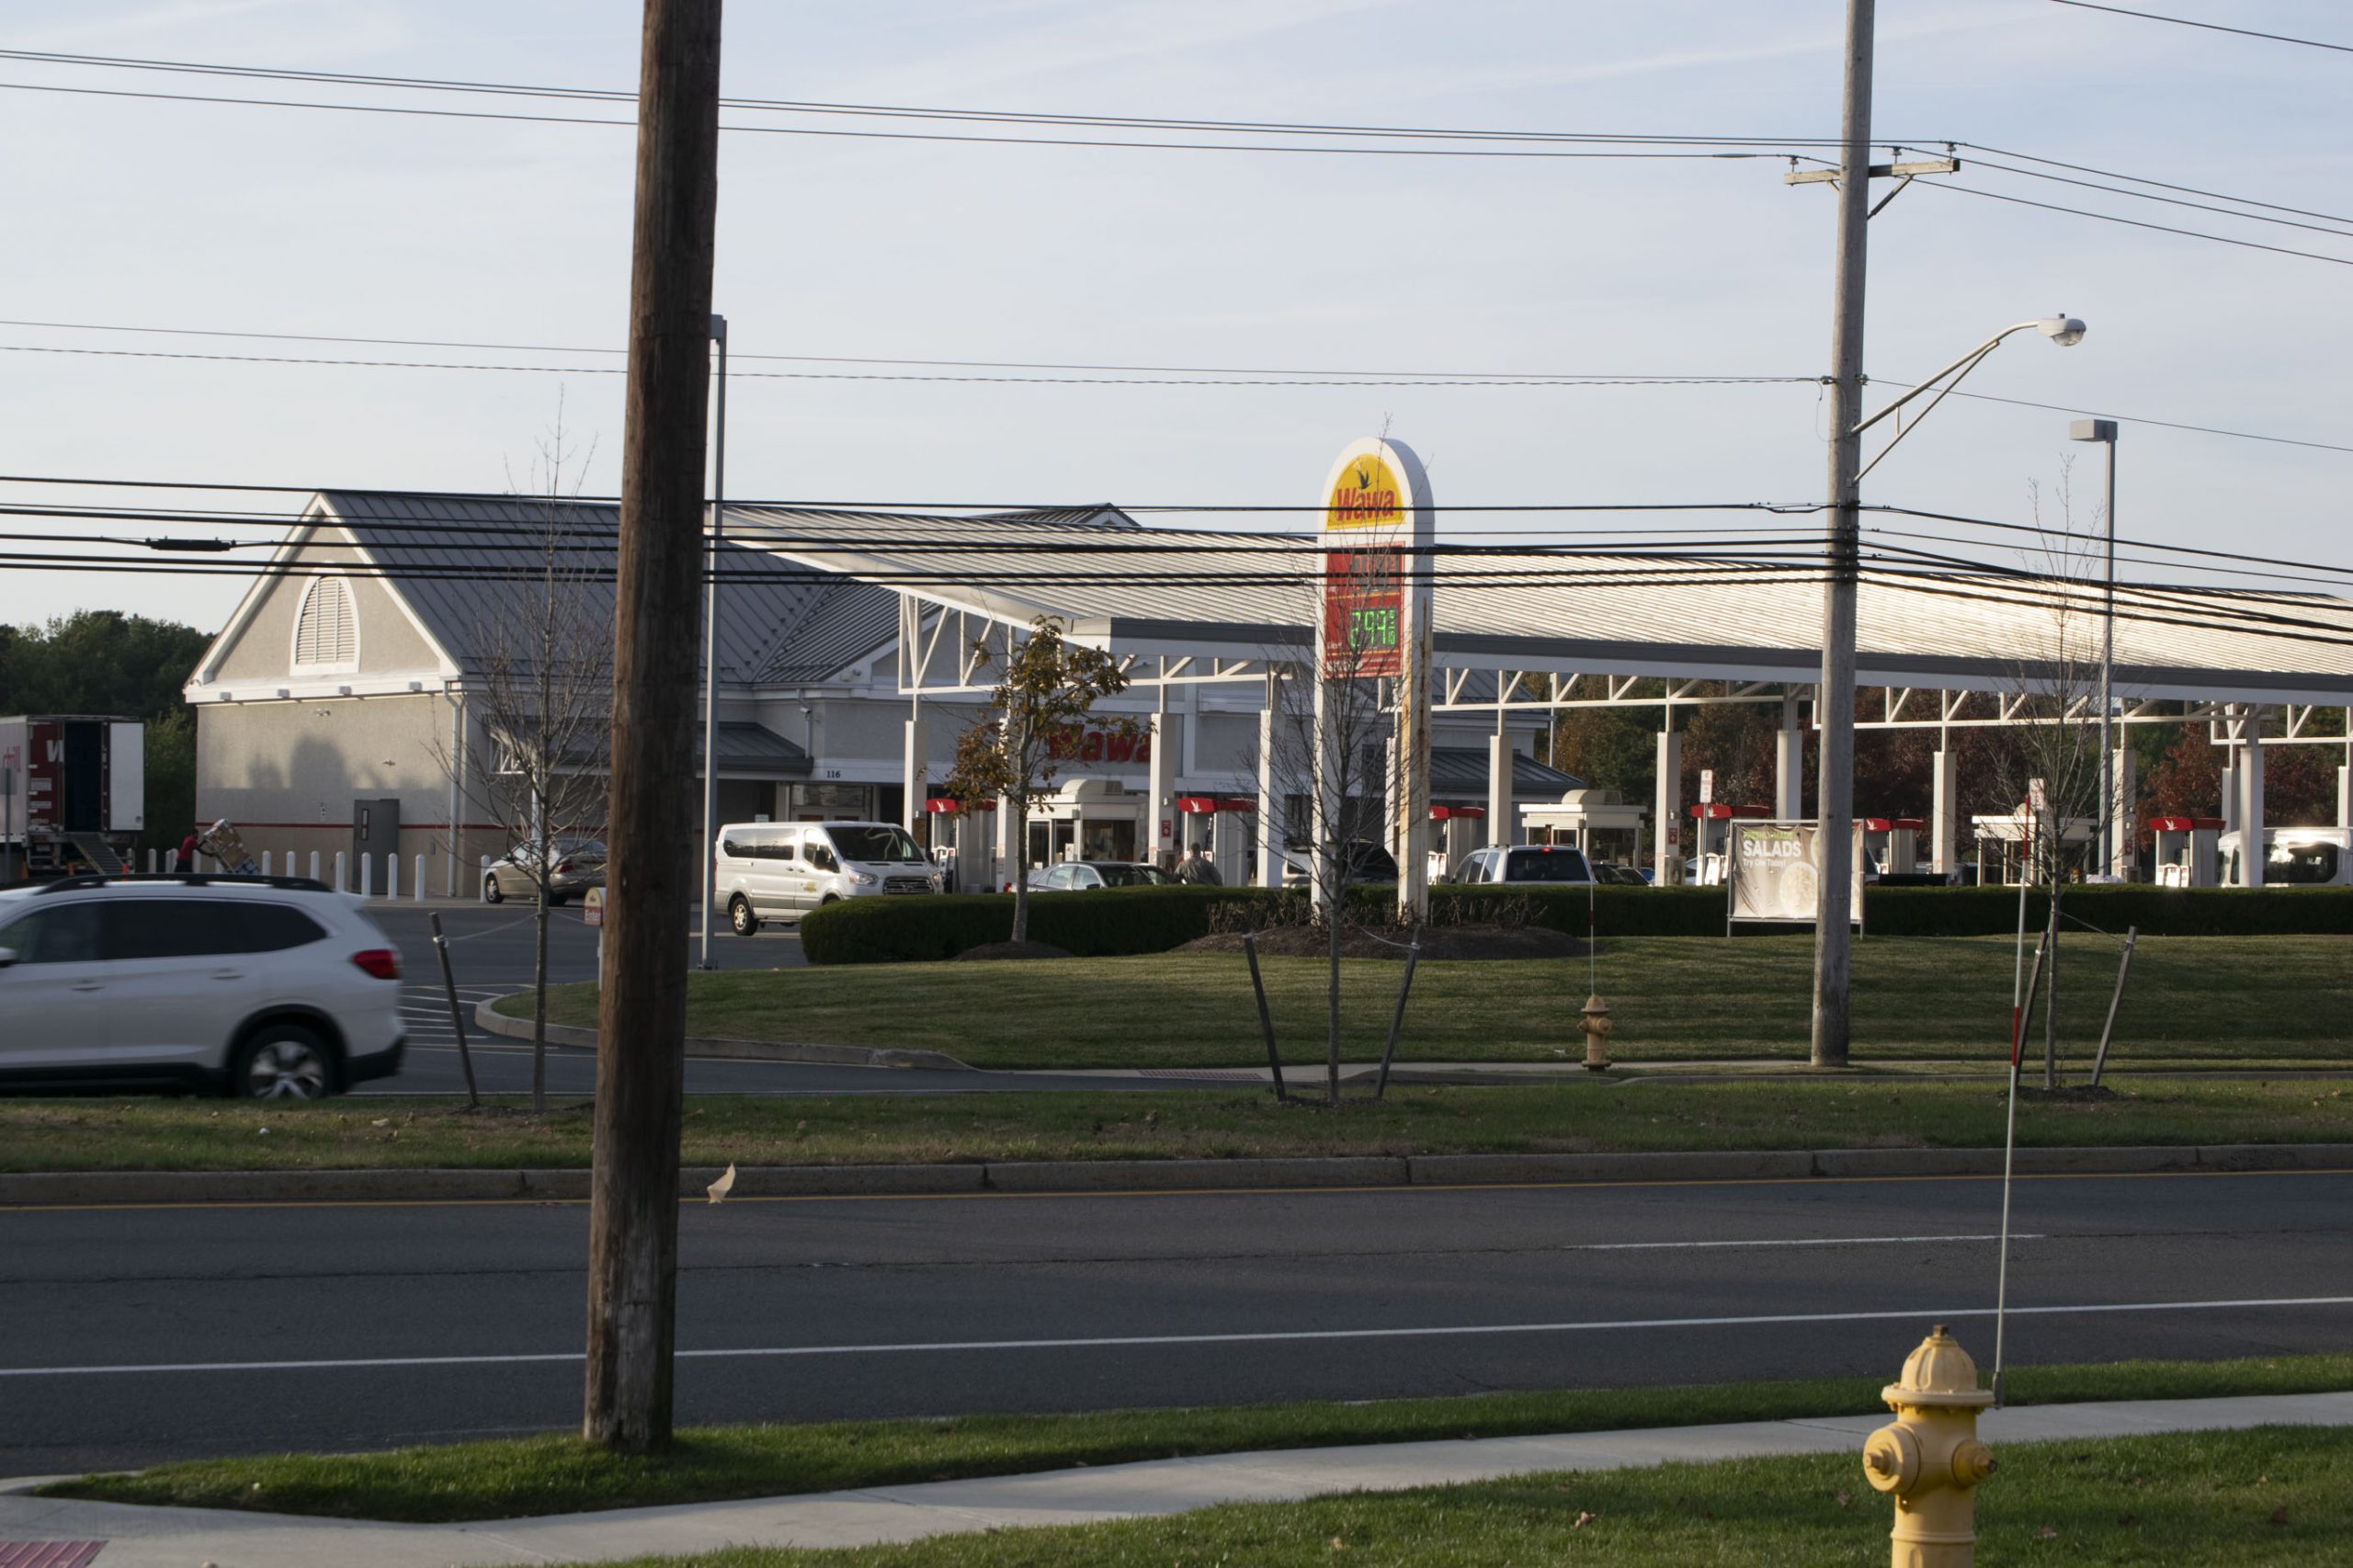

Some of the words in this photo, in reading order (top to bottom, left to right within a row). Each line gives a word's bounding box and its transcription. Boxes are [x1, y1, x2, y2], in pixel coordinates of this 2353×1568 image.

[1337, 487, 1394, 521] Wawa
[827, 770, 841, 778] 116
[1743, 840, 1802, 857] SALADS
